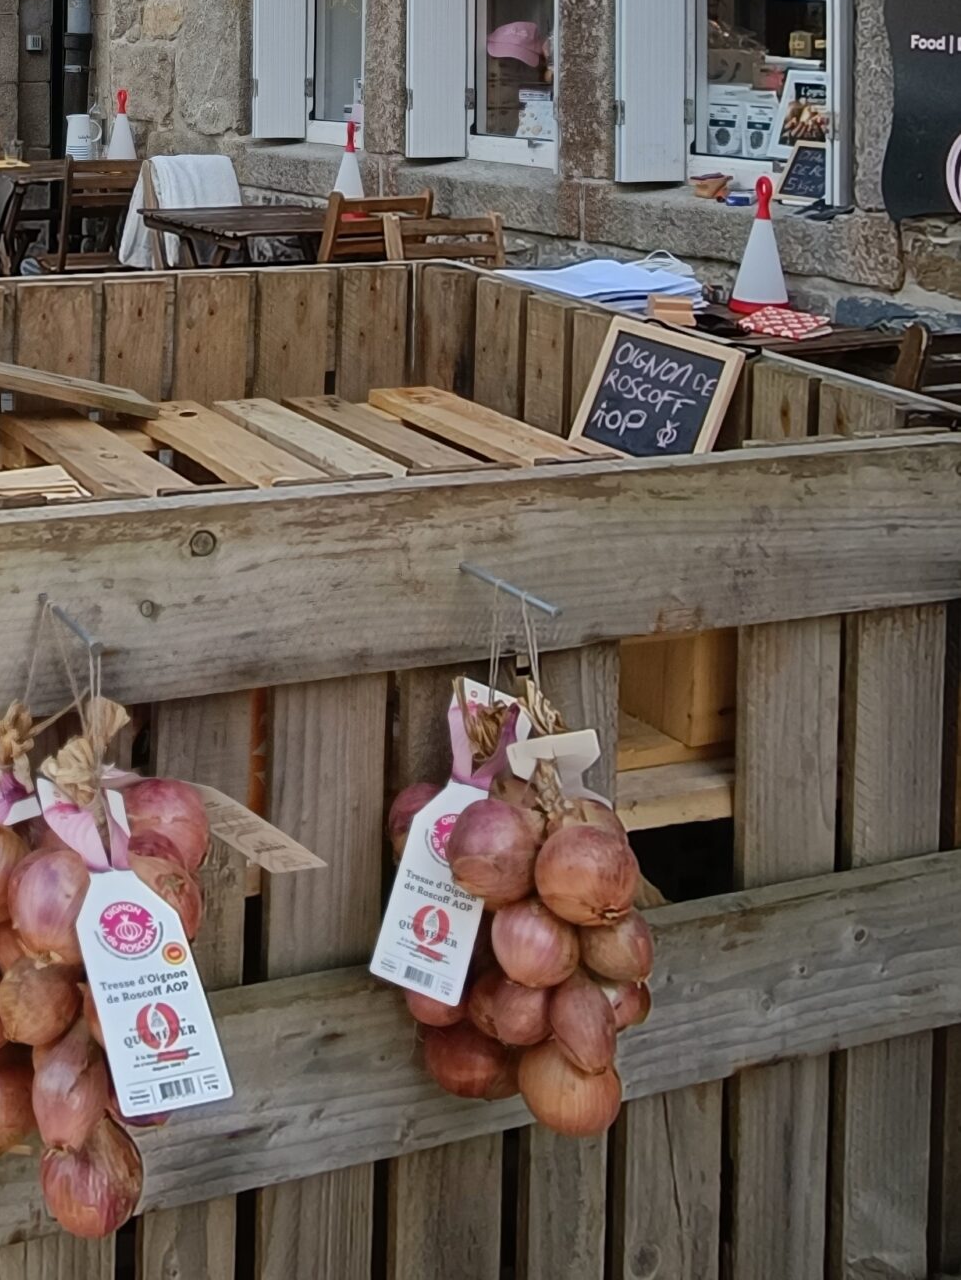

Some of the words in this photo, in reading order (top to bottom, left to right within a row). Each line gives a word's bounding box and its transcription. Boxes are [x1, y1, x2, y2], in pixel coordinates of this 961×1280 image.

[910, 34, 946, 51] Food
[615, 341, 694, 388] OIGNON
[692, 372, 719, 397] DE
[604, 368, 697, 417] ROSCOFF
[405, 868, 435, 886] Tresse
[404, 880, 416, 892] de
[417, 885, 452, 905] Roscoff
[451, 900, 474, 913] AOP
[103, 903, 143, 921] OIGNON
[99, 979, 136, 992] Tresse
[138, 969, 189, 986] d'Oignon
[106, 993, 121, 1005] de
[121, 985, 163, 1003] Roscoff
[165, 980, 190, 995] AOP
